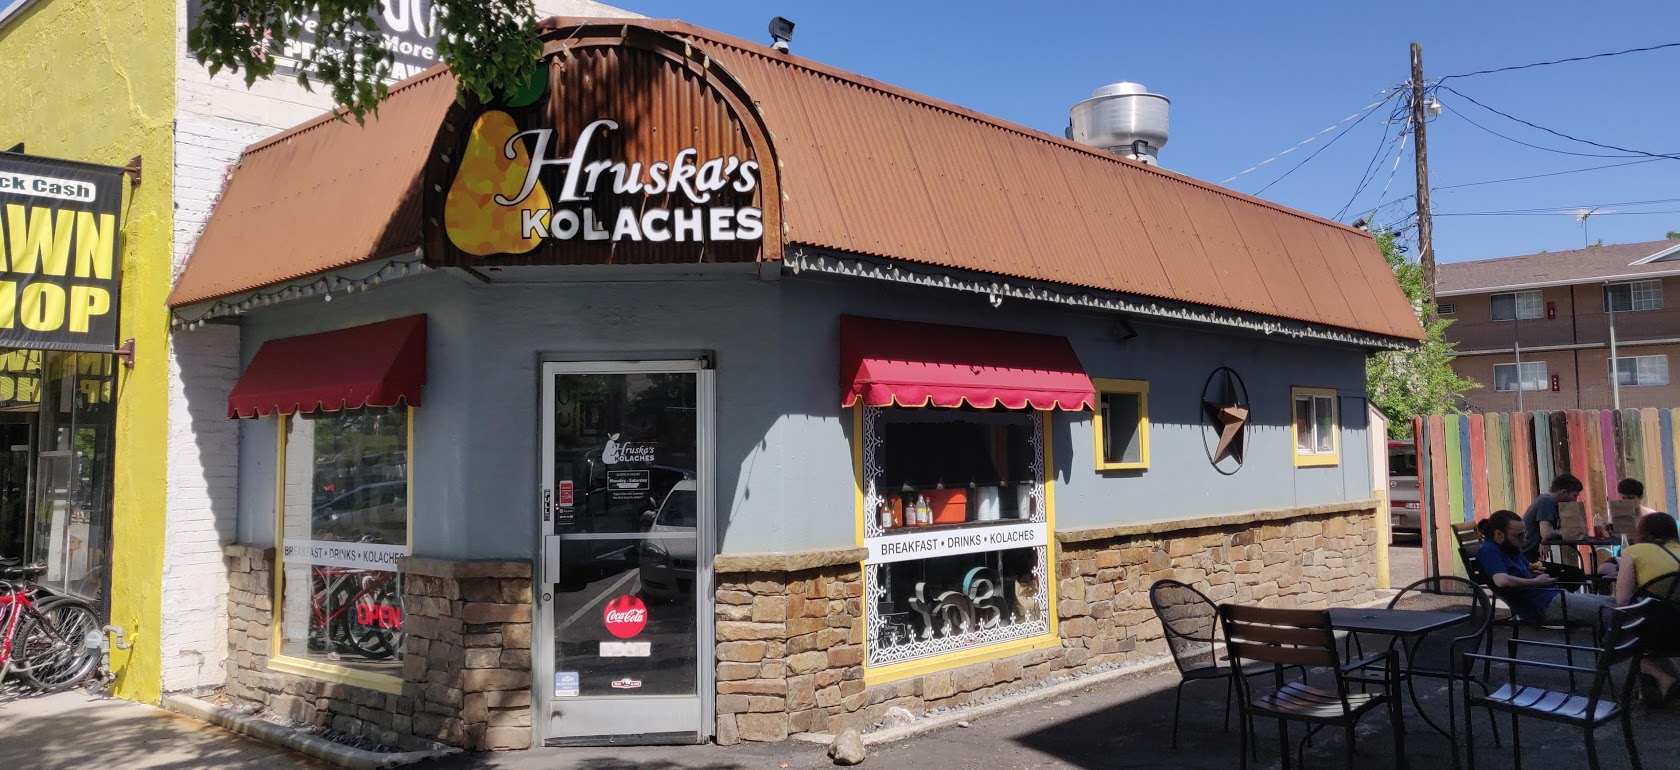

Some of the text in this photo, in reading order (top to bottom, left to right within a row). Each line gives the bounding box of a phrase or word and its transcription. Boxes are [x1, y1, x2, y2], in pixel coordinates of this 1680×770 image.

[379, 33, 434, 60] More
[494, 118, 759, 207] Hruska's
[521, 207, 764, 242] KOLACHES
[0, 203, 115, 280] WN
[610, 441, 655, 456] Hruska's
[614, 454, 655, 462] KOLACHES
[285, 546, 323, 559] BREAKFAST
[329, 549, 356, 562] DRINKS
[881, 530, 1035, 556] BREAKFAST DRINKS KOLACHES
[357, 603, 401, 630] OPEN
[606, 608, 646, 624] Coca-Cola
